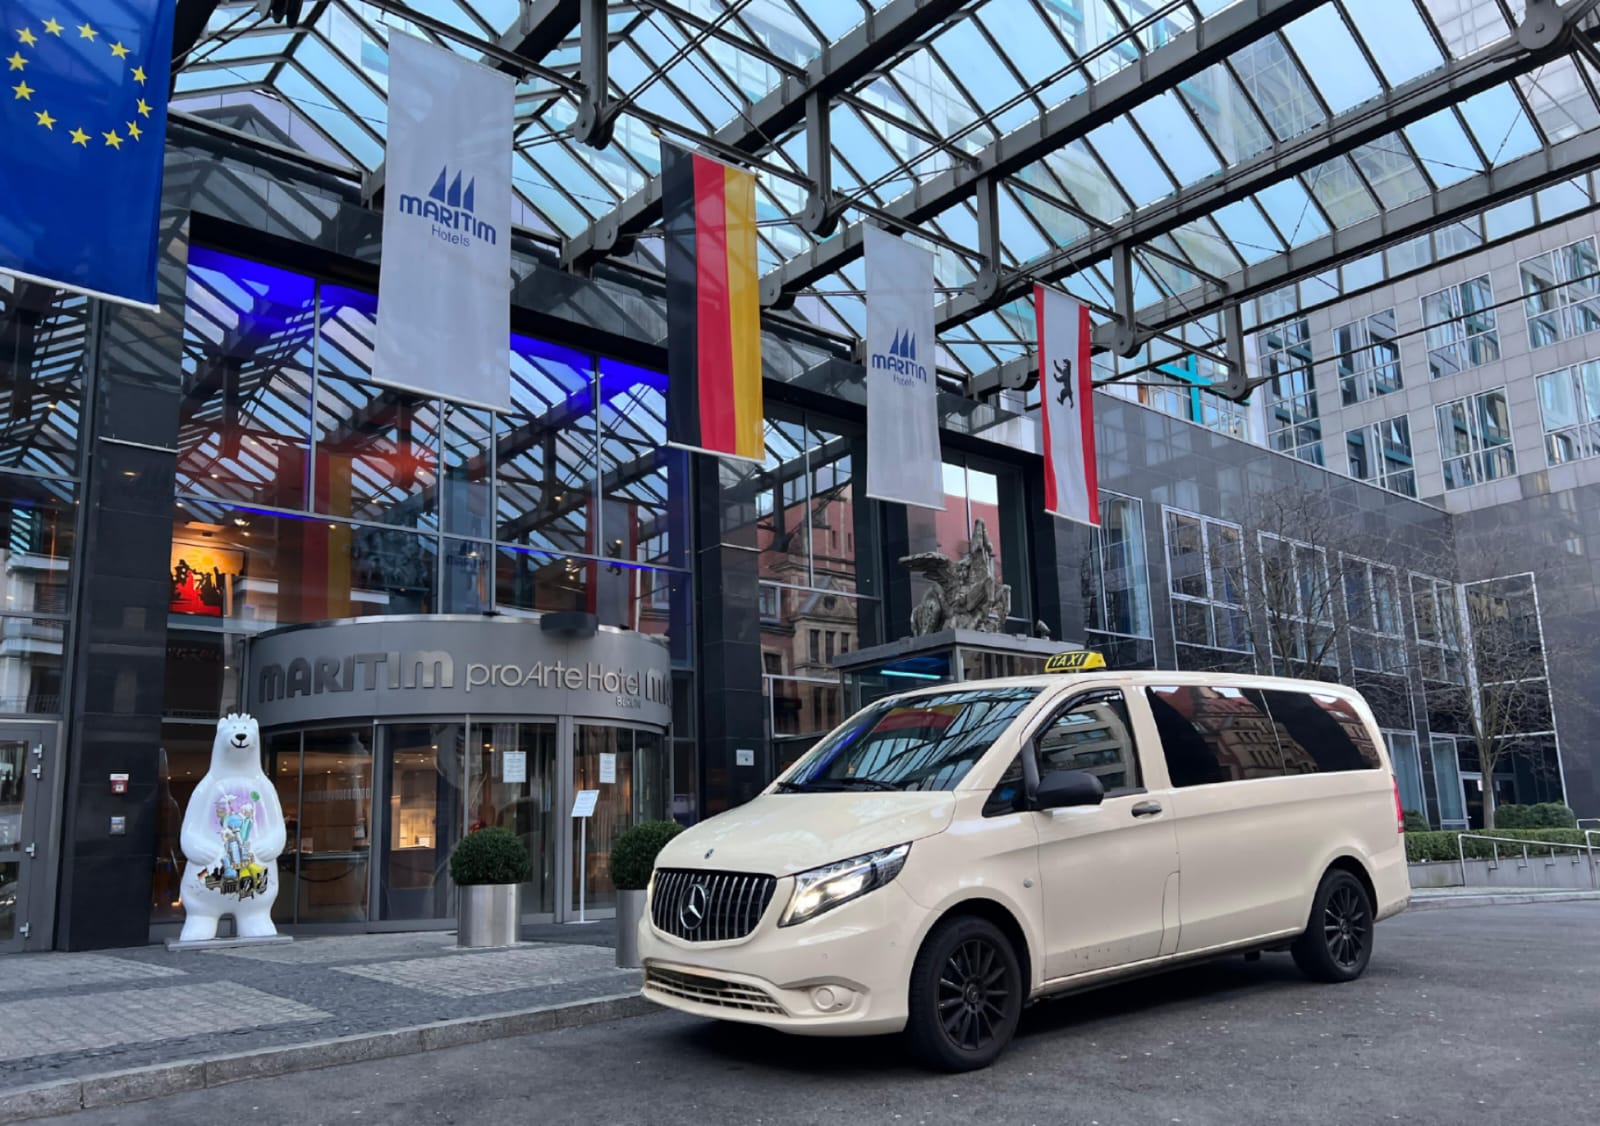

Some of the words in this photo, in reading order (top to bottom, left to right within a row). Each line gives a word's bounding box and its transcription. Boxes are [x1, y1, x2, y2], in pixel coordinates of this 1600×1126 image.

[400, 193, 496, 245] MARITIM
[431, 224, 471, 248] Hotels
[872, 353, 927, 384] MARITIM
[1052, 653, 1086, 667] TAXI
[259, 650, 455, 704] MARITIM
